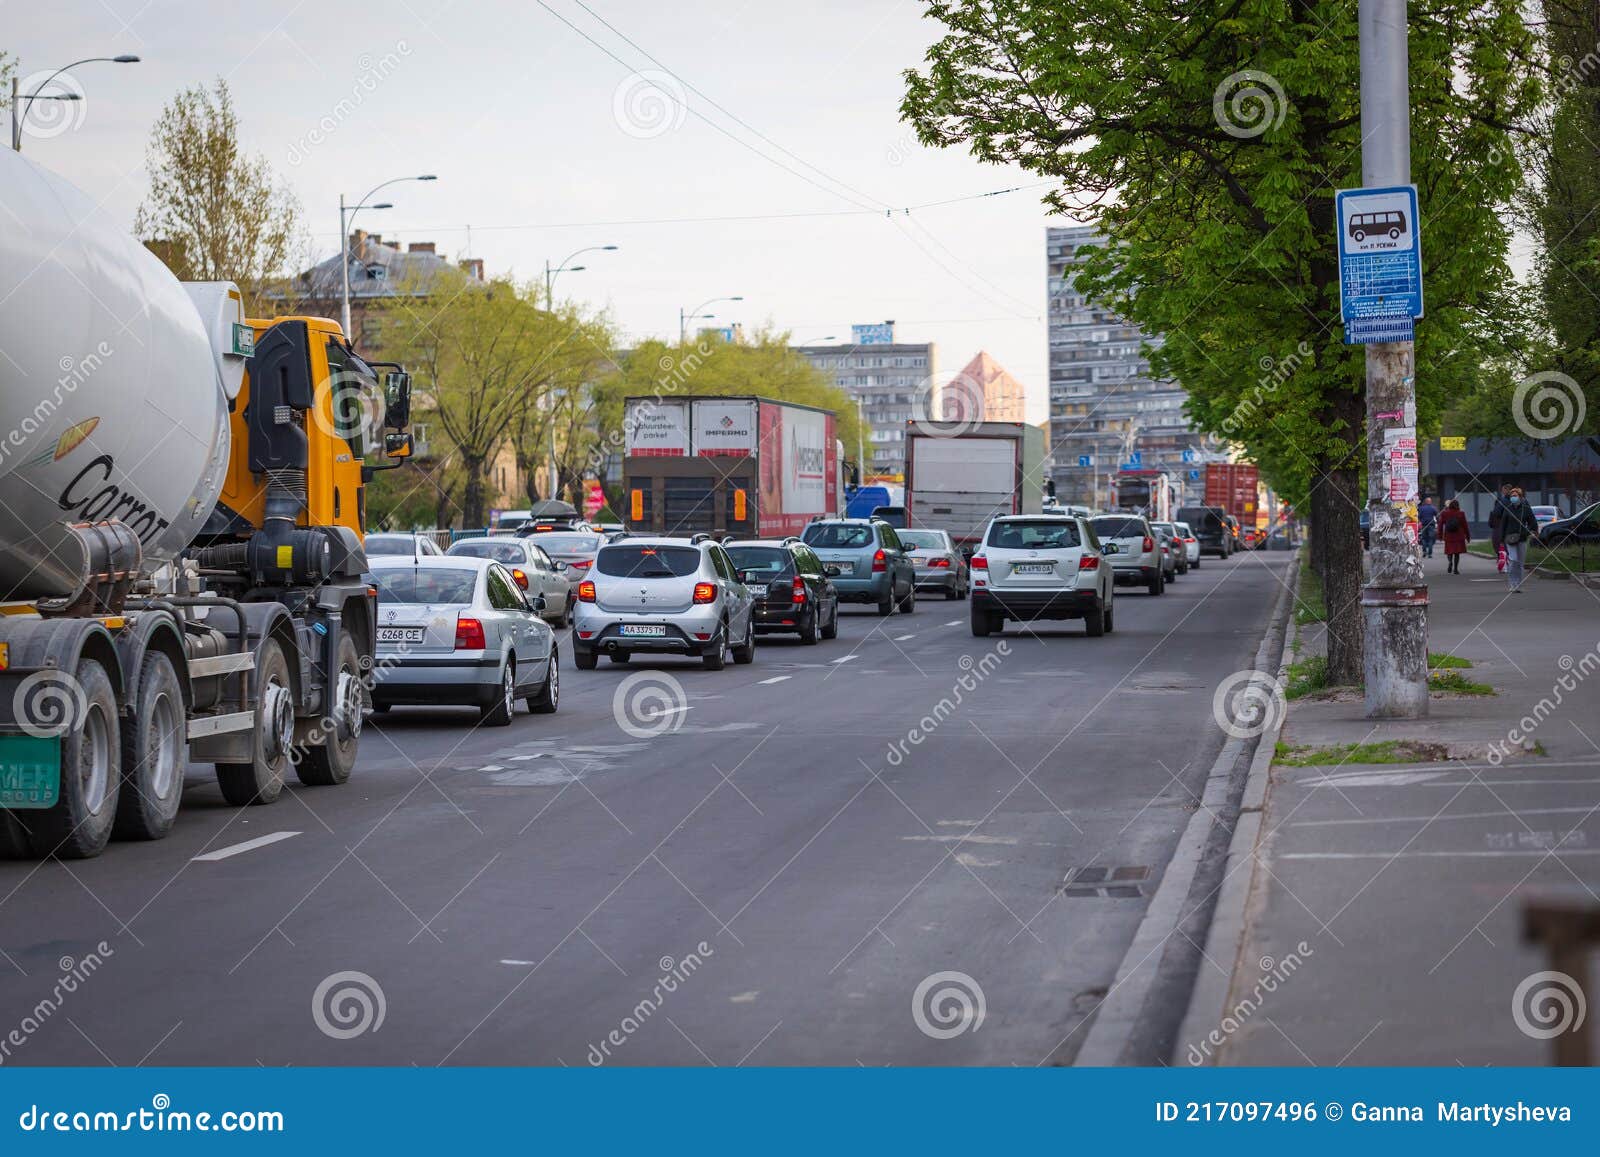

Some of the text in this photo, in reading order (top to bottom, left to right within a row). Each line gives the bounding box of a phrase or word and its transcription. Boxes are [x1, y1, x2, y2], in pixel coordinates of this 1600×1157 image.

[637, 626, 654, 634] 3375
[381, 630, 419, 640] 6268 CE
